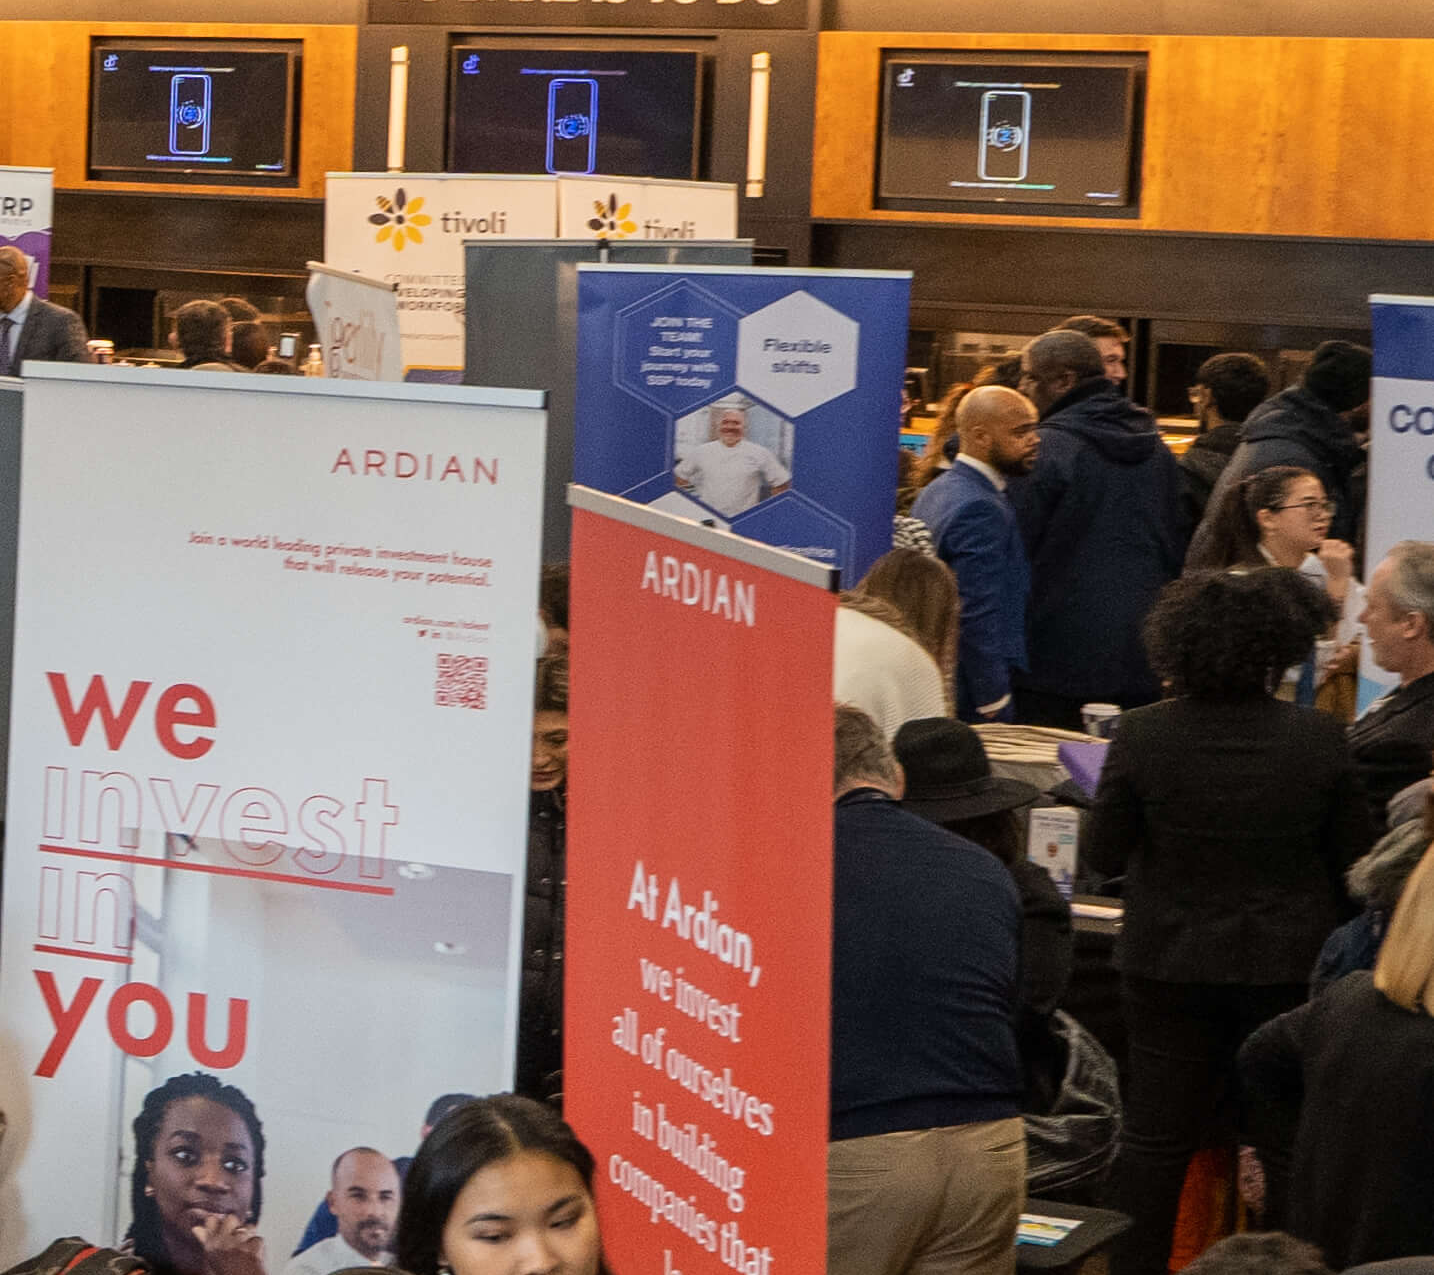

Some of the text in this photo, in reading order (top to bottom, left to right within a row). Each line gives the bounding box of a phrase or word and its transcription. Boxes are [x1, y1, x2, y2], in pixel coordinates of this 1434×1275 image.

[440, 212, 508, 235] tivoli
[643, 219, 696, 238] tivoli
[763, 338, 832, 354] Flexible
[771, 360, 821, 374] shifts
[332, 448, 499, 485] ARDIAN
[189, 531, 493, 569] Join a world leading private investment house
[283, 556, 493, 587] that will release your potential.
[640, 548, 757, 629] ARDIAN
[46, 671, 218, 761] we
[43, 765, 400, 880] invest
[38, 865, 137, 951] in
[626, 859, 762, 988] At Ardian,
[33, 968, 250, 1078] you
[639, 957, 743, 1044] we invest
[611, 1007, 775, 1136] all of ourselves
[632, 1090, 747, 1213] in building
[608, 1154, 718, 1253] companies
